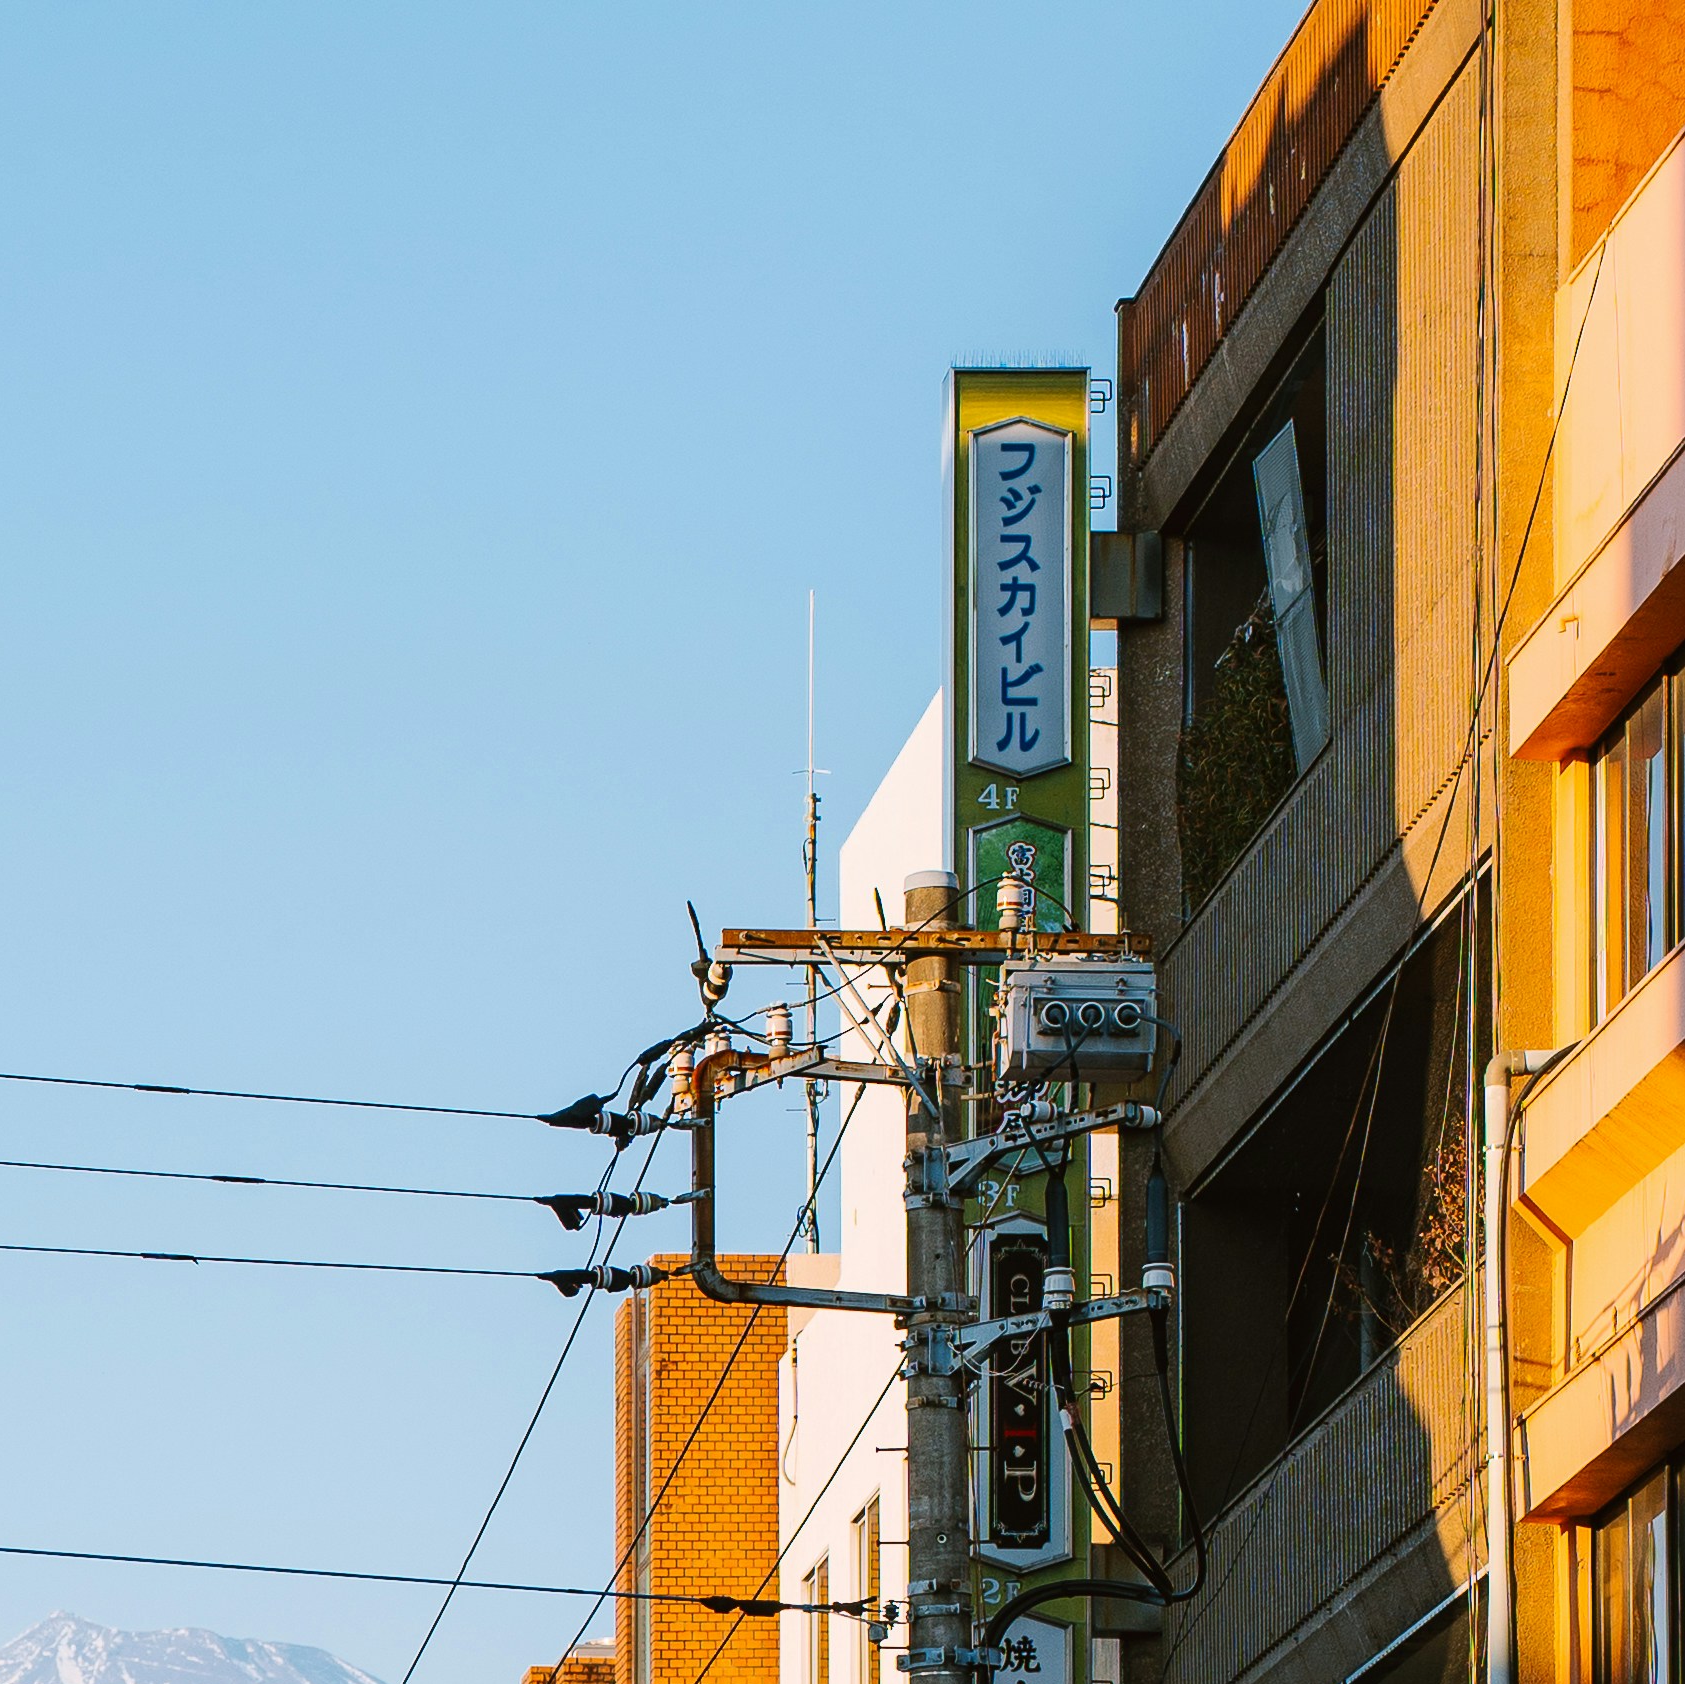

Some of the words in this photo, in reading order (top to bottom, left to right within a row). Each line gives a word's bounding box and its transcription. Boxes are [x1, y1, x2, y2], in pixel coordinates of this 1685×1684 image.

[996, 442, 1044, 753] フジスカイビル
[977, 783, 1020, 810] 4F
[1009, 1272, 1030, 1356] CLB
